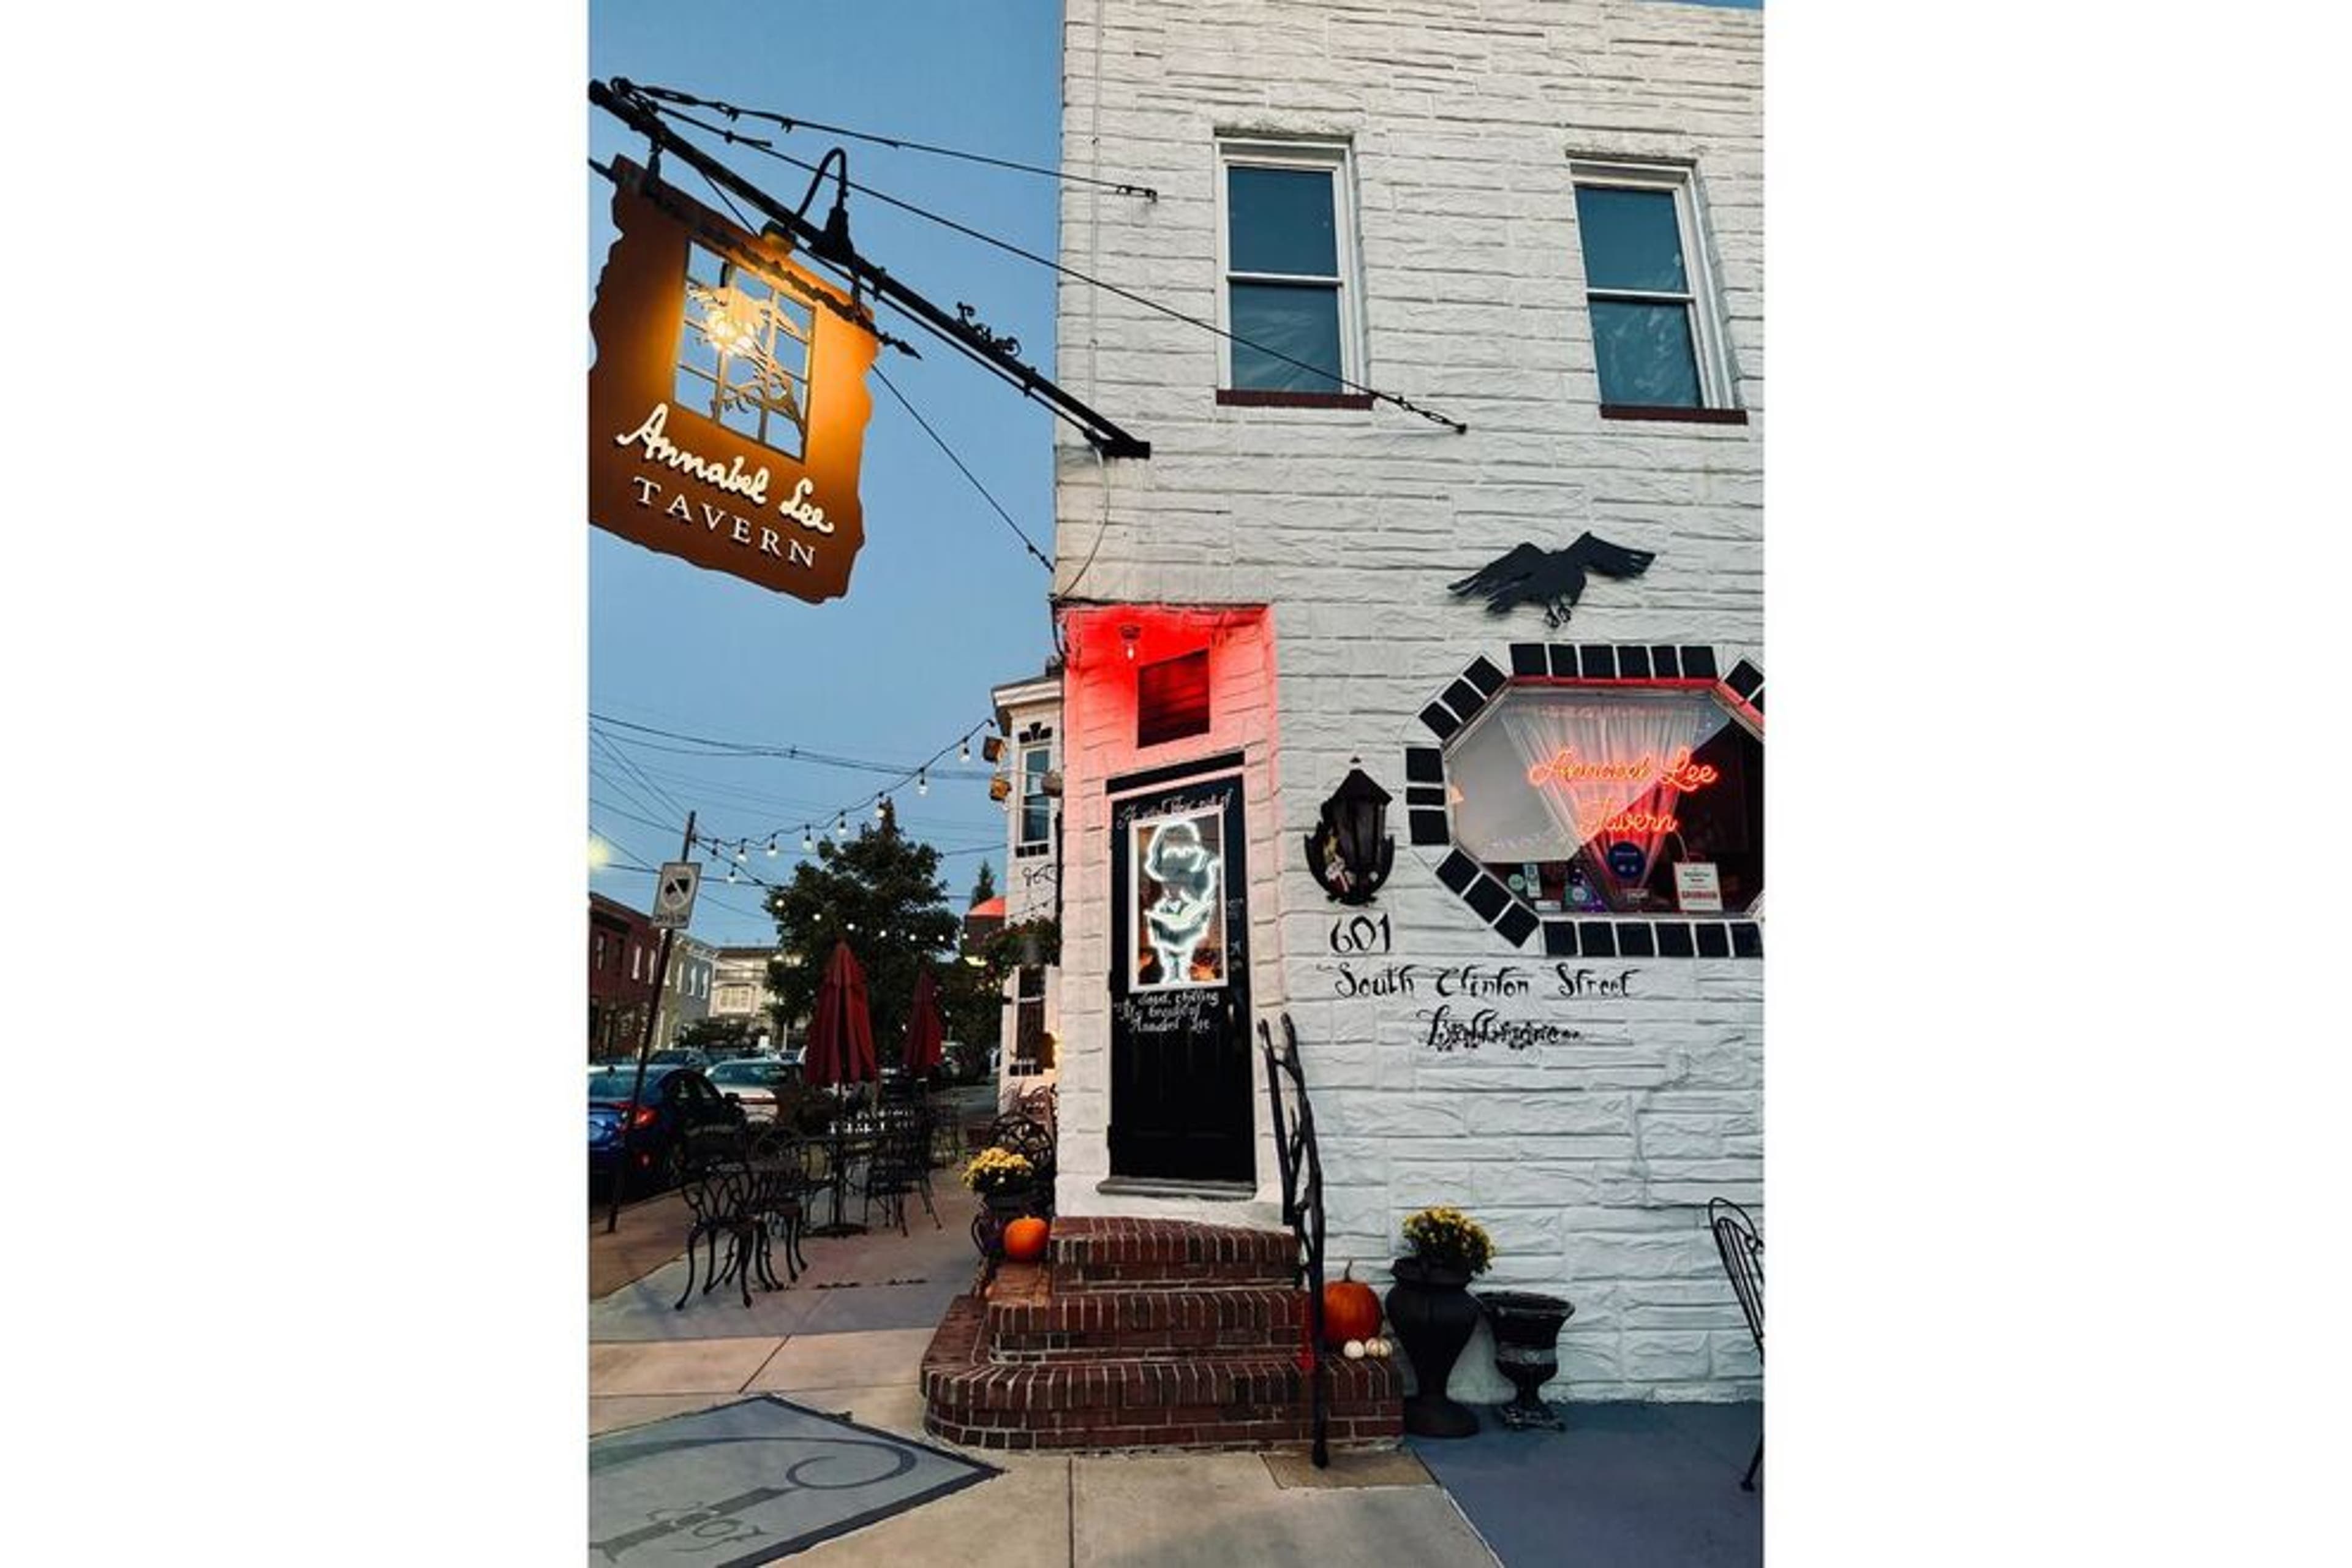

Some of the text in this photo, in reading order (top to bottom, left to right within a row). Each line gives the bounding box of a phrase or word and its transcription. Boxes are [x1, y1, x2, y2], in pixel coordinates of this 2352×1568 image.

[616, 403, 834, 533] Annabel Lee
[633, 476, 815, 568] TAVERN
[1657, 746, 1718, 792] Lee
[1578, 796, 1678, 837] Tavern
[1329, 913, 1390, 954] 601
[1326, 962, 1641, 998] South Clinton Street
